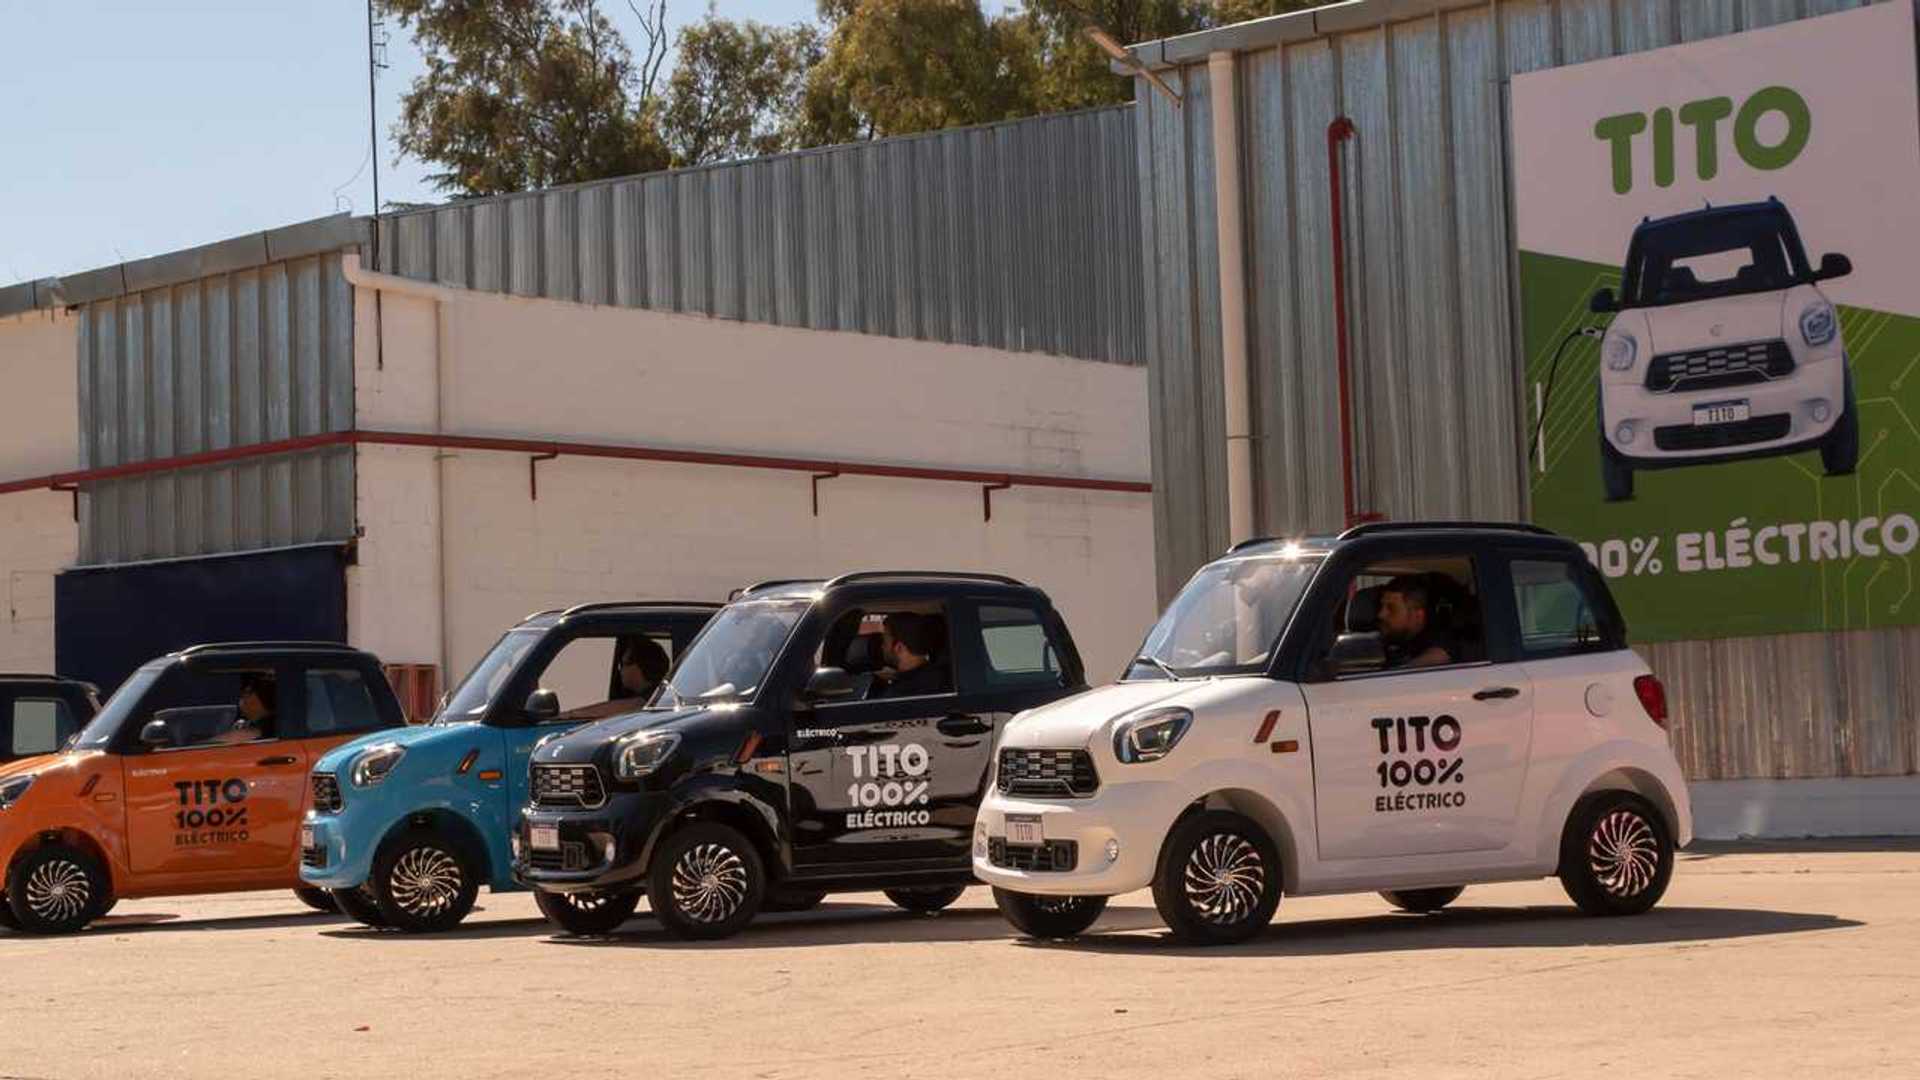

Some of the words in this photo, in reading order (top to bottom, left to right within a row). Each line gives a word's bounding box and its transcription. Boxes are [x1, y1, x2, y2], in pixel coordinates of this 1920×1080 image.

[1594, 85, 1811, 195] TITO
[1676, 516, 1919, 573] ELÉCTRICO
[1371, 714, 1461, 754] TITO
[846, 743, 929, 778] TITO
[1377, 757, 1464, 788] 100%
[175, 778, 248, 805] TITO
[847, 781, 929, 807] 100%
[1375, 790, 1465, 812] ELÉCTRICO
[175, 807, 248, 828] 100%
[846, 809, 930, 829] ELÉCTRICO
